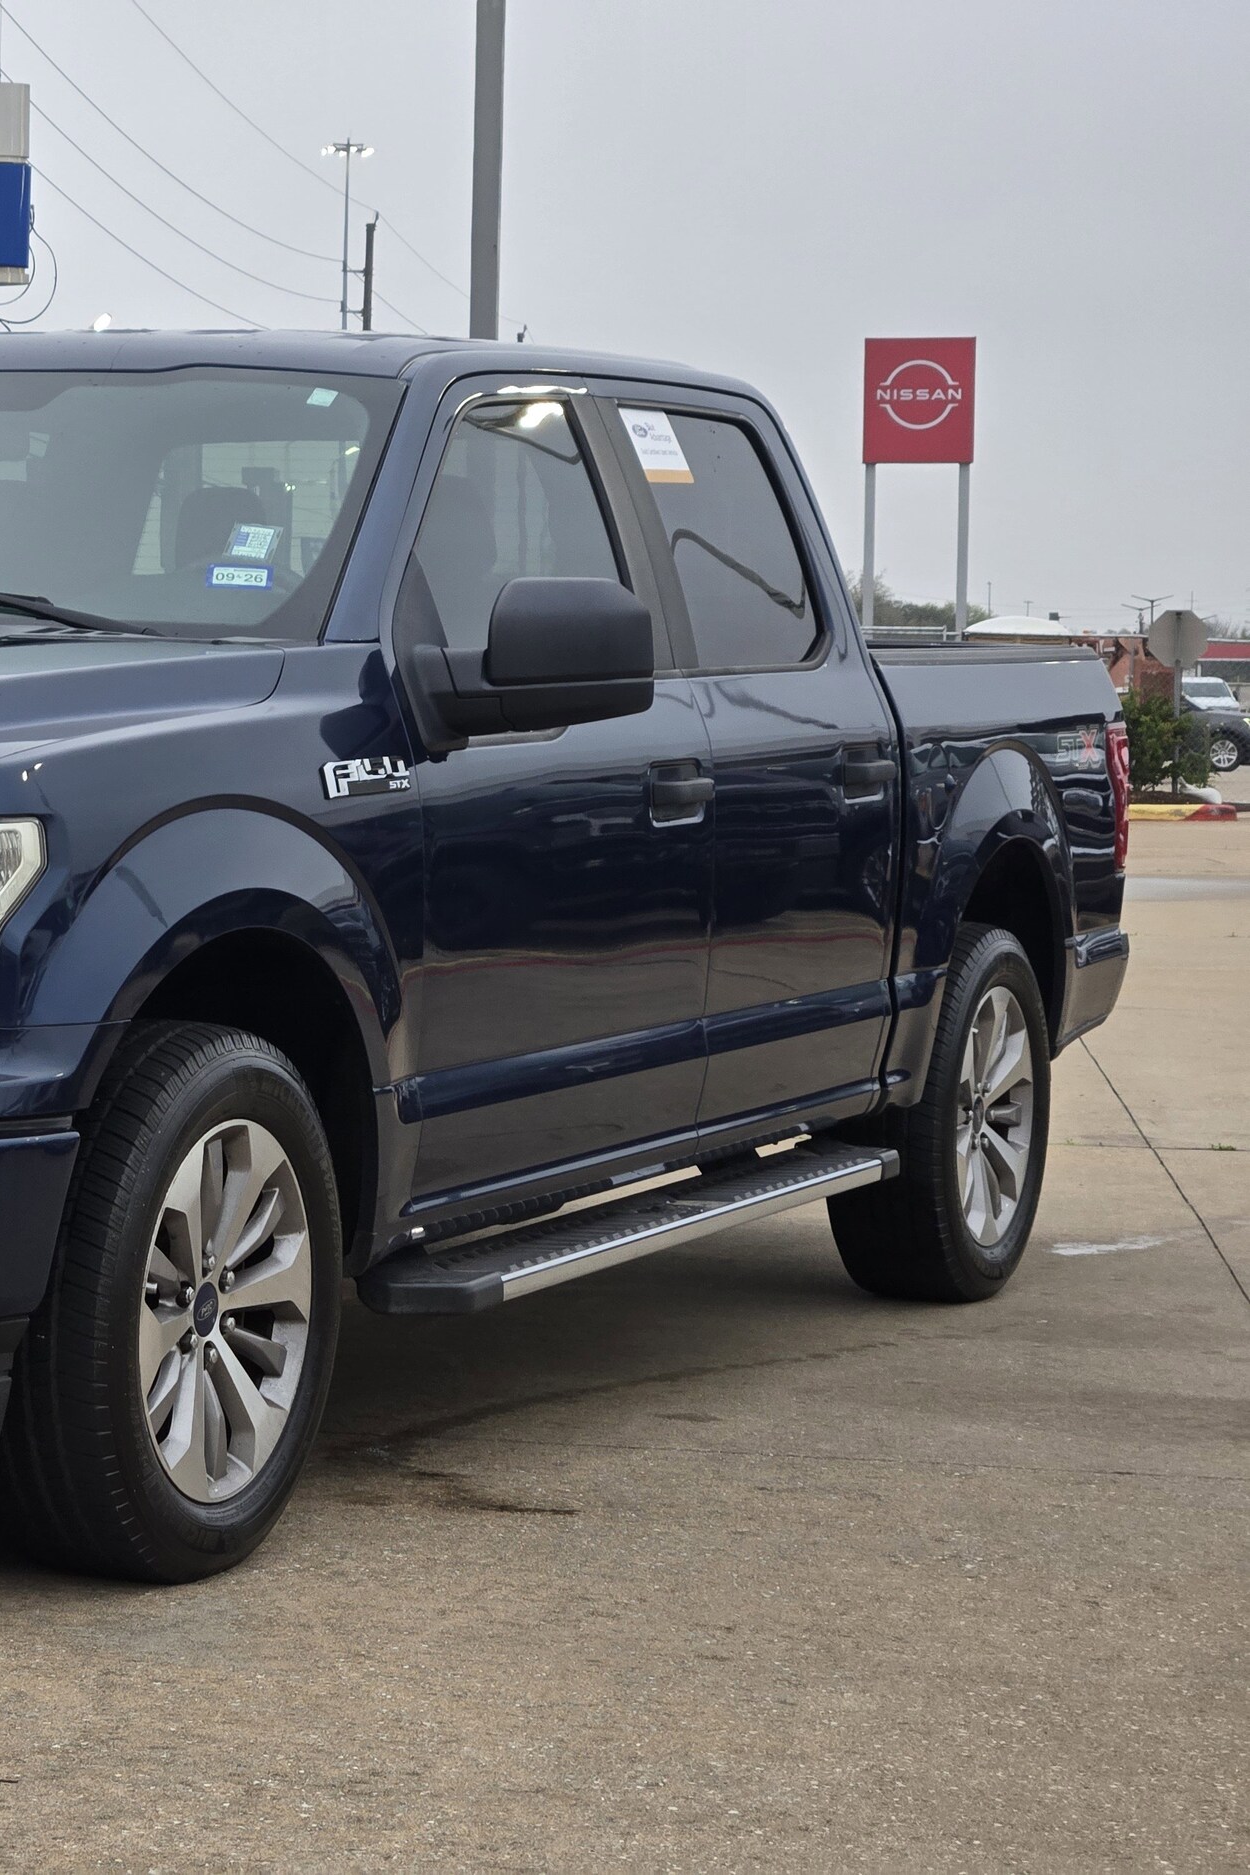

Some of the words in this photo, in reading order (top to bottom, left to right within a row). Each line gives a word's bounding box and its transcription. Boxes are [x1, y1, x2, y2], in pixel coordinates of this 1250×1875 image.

[876, 388, 962, 401] NISSAN
[215, 572, 235, 582] 09
[243, 573, 264, 583] 26
[389, 778, 411, 790] STX
